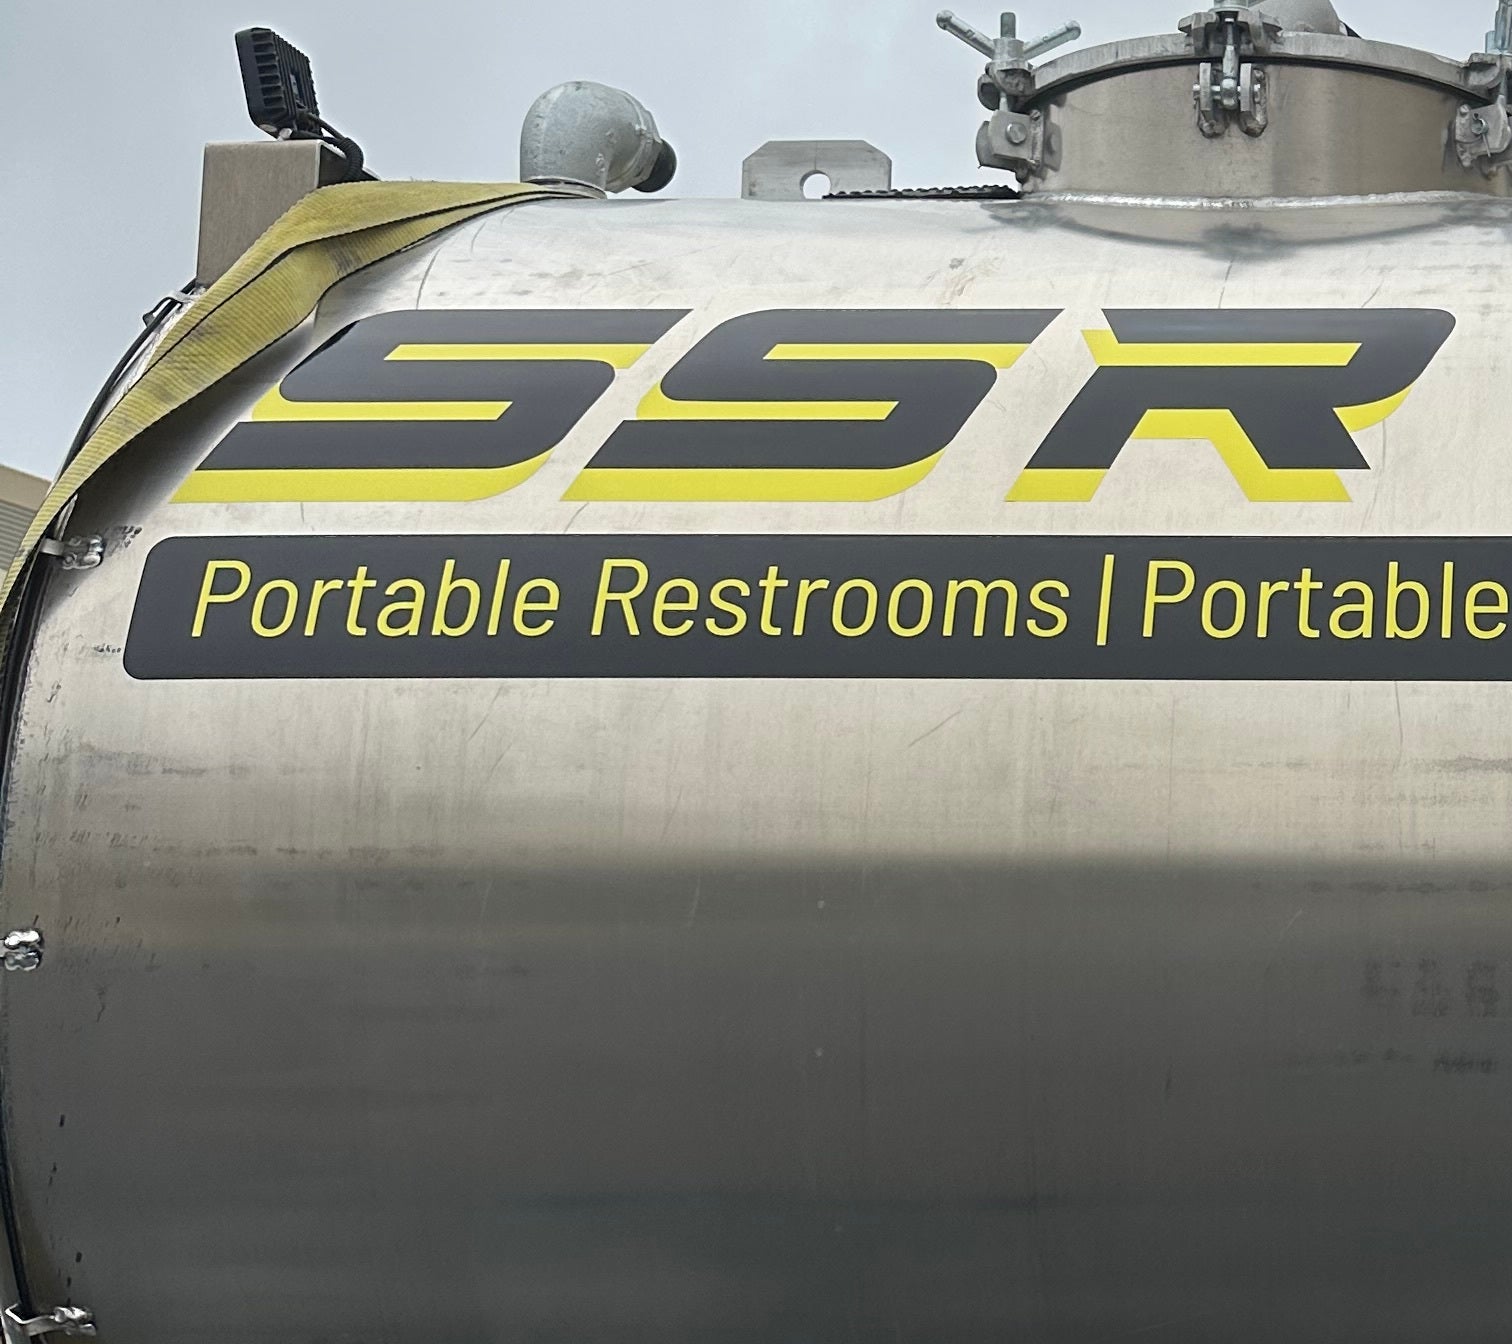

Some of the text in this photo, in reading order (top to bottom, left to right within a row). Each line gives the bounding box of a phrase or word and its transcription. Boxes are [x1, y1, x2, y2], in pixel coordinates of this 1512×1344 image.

[170, 308, 1456, 503] SSR
[191, 558, 560, 638] Portable
[591, 557, 1070, 638] Restrooms
[1141, 559, 1509, 640] Portable
